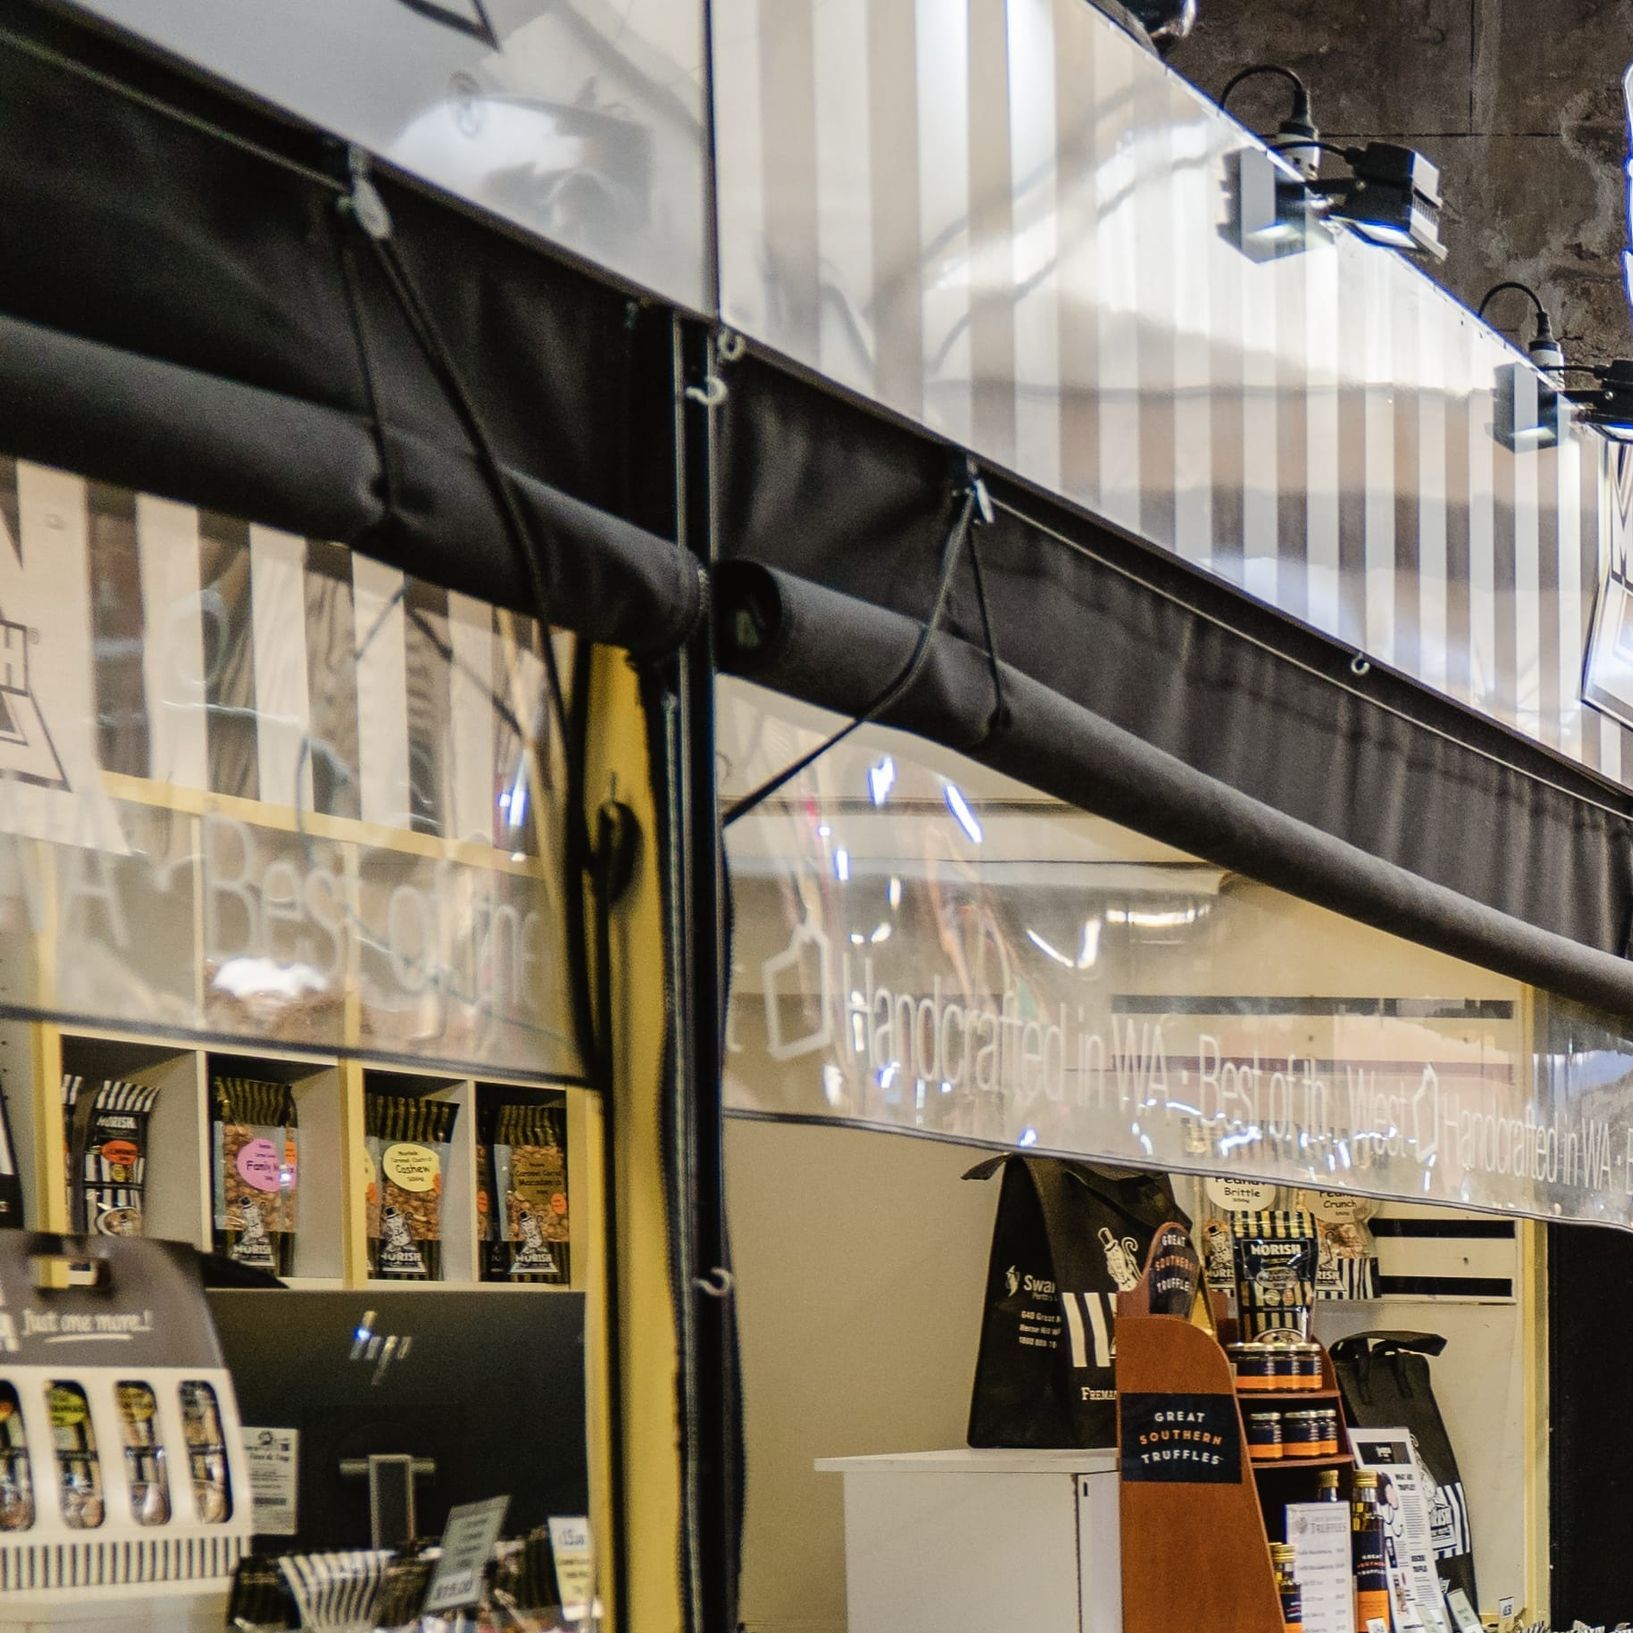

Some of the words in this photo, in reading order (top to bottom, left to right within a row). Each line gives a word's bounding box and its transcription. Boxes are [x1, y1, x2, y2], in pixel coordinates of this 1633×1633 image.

[843, 951, 1066, 1103] Handcrafted
[1224, 1186, 1261, 1199] Brittle
[1322, 1199, 1358, 1210] Crunch
[1161, 1233, 1187, 1247] GREAT
[1250, 1242, 1302, 1257] MORISH
[515, 1252, 552, 1263] MORISH
[22, 1309, 58, 1336] Just
[60, 1311, 92, 1332] one
[1154, 1411, 1206, 1423] GREAT
[1139, 1429, 1223, 1446] SOUTHERN
[1140, 1449, 1221, 1465] TRUFFLES
